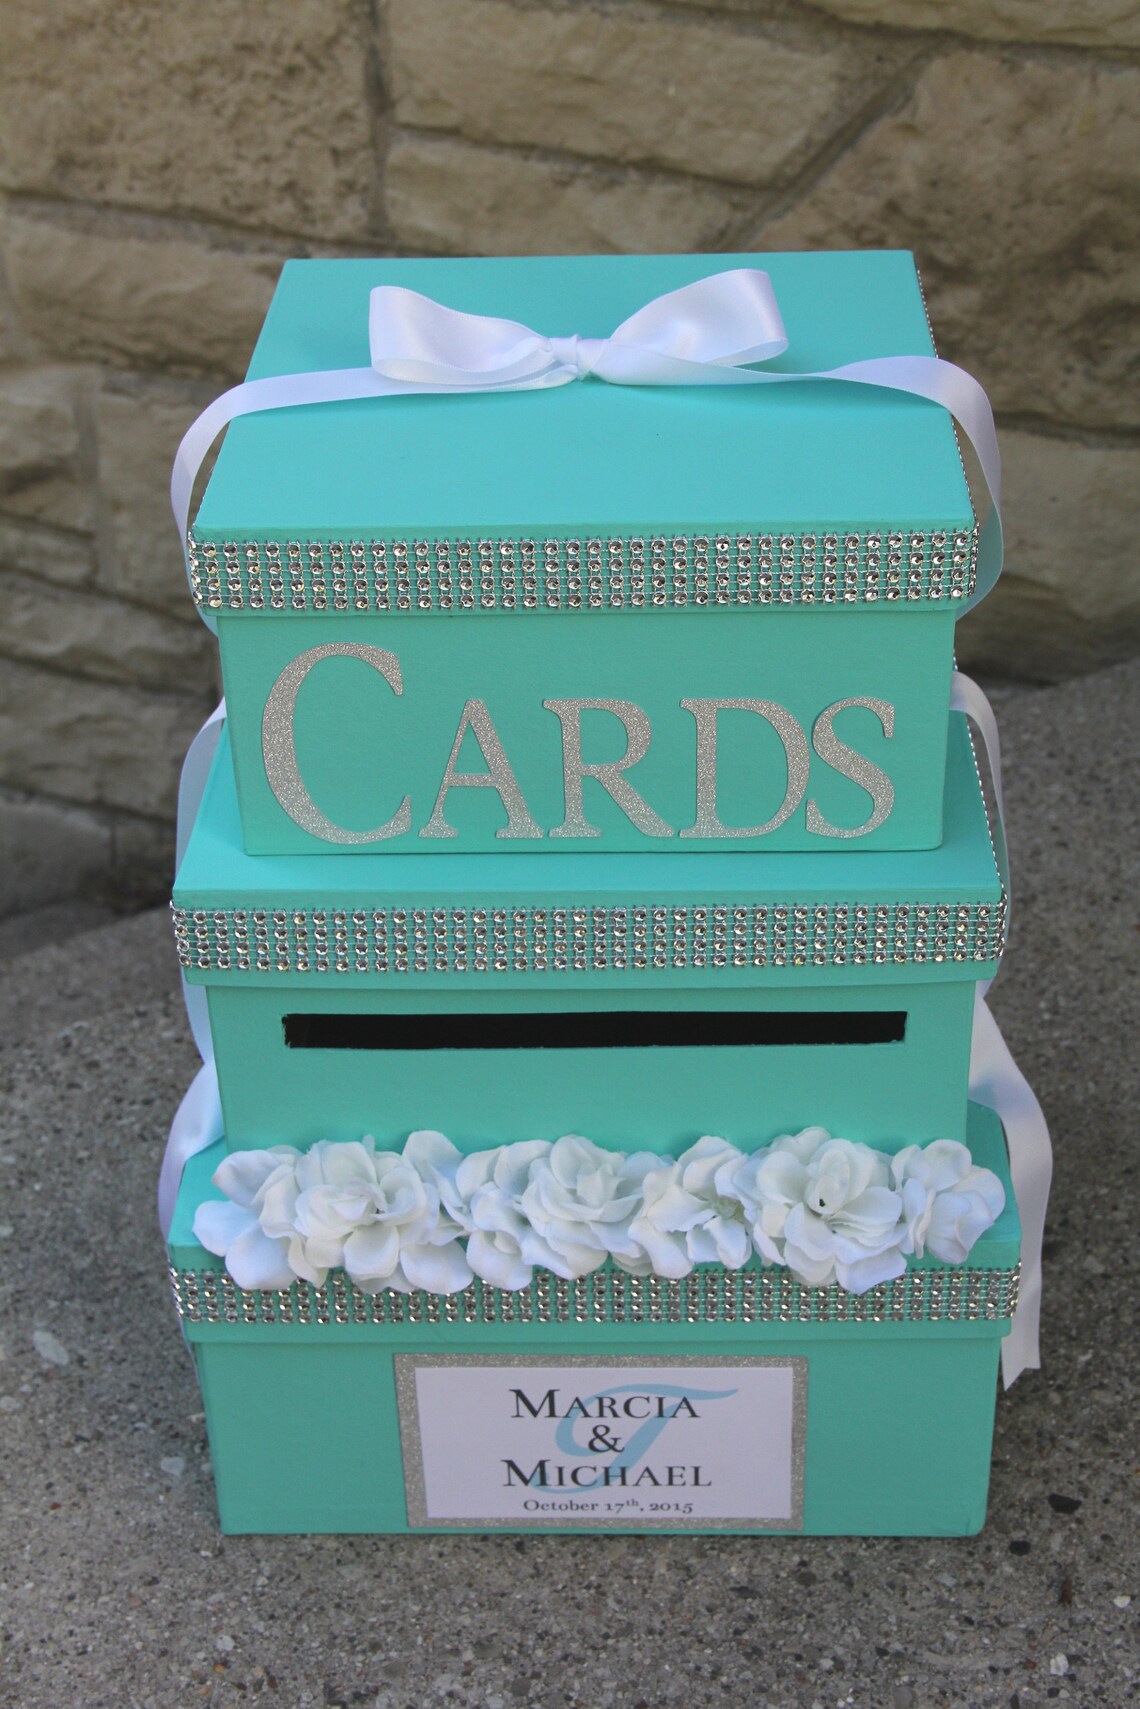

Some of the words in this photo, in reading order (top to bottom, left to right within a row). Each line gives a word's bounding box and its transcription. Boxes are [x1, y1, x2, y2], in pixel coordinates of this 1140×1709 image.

[261, 641, 895, 845] CARDS
[508, 1388, 701, 1419] MARCIA
[588, 1424, 625, 1453] &
[500, 1458, 713, 1488] MICHAEL
[523, 1499, 599, 1513] October
[604, 1498, 645, 1515] 17th,
[649, 1501, 694, 1515] 2015
